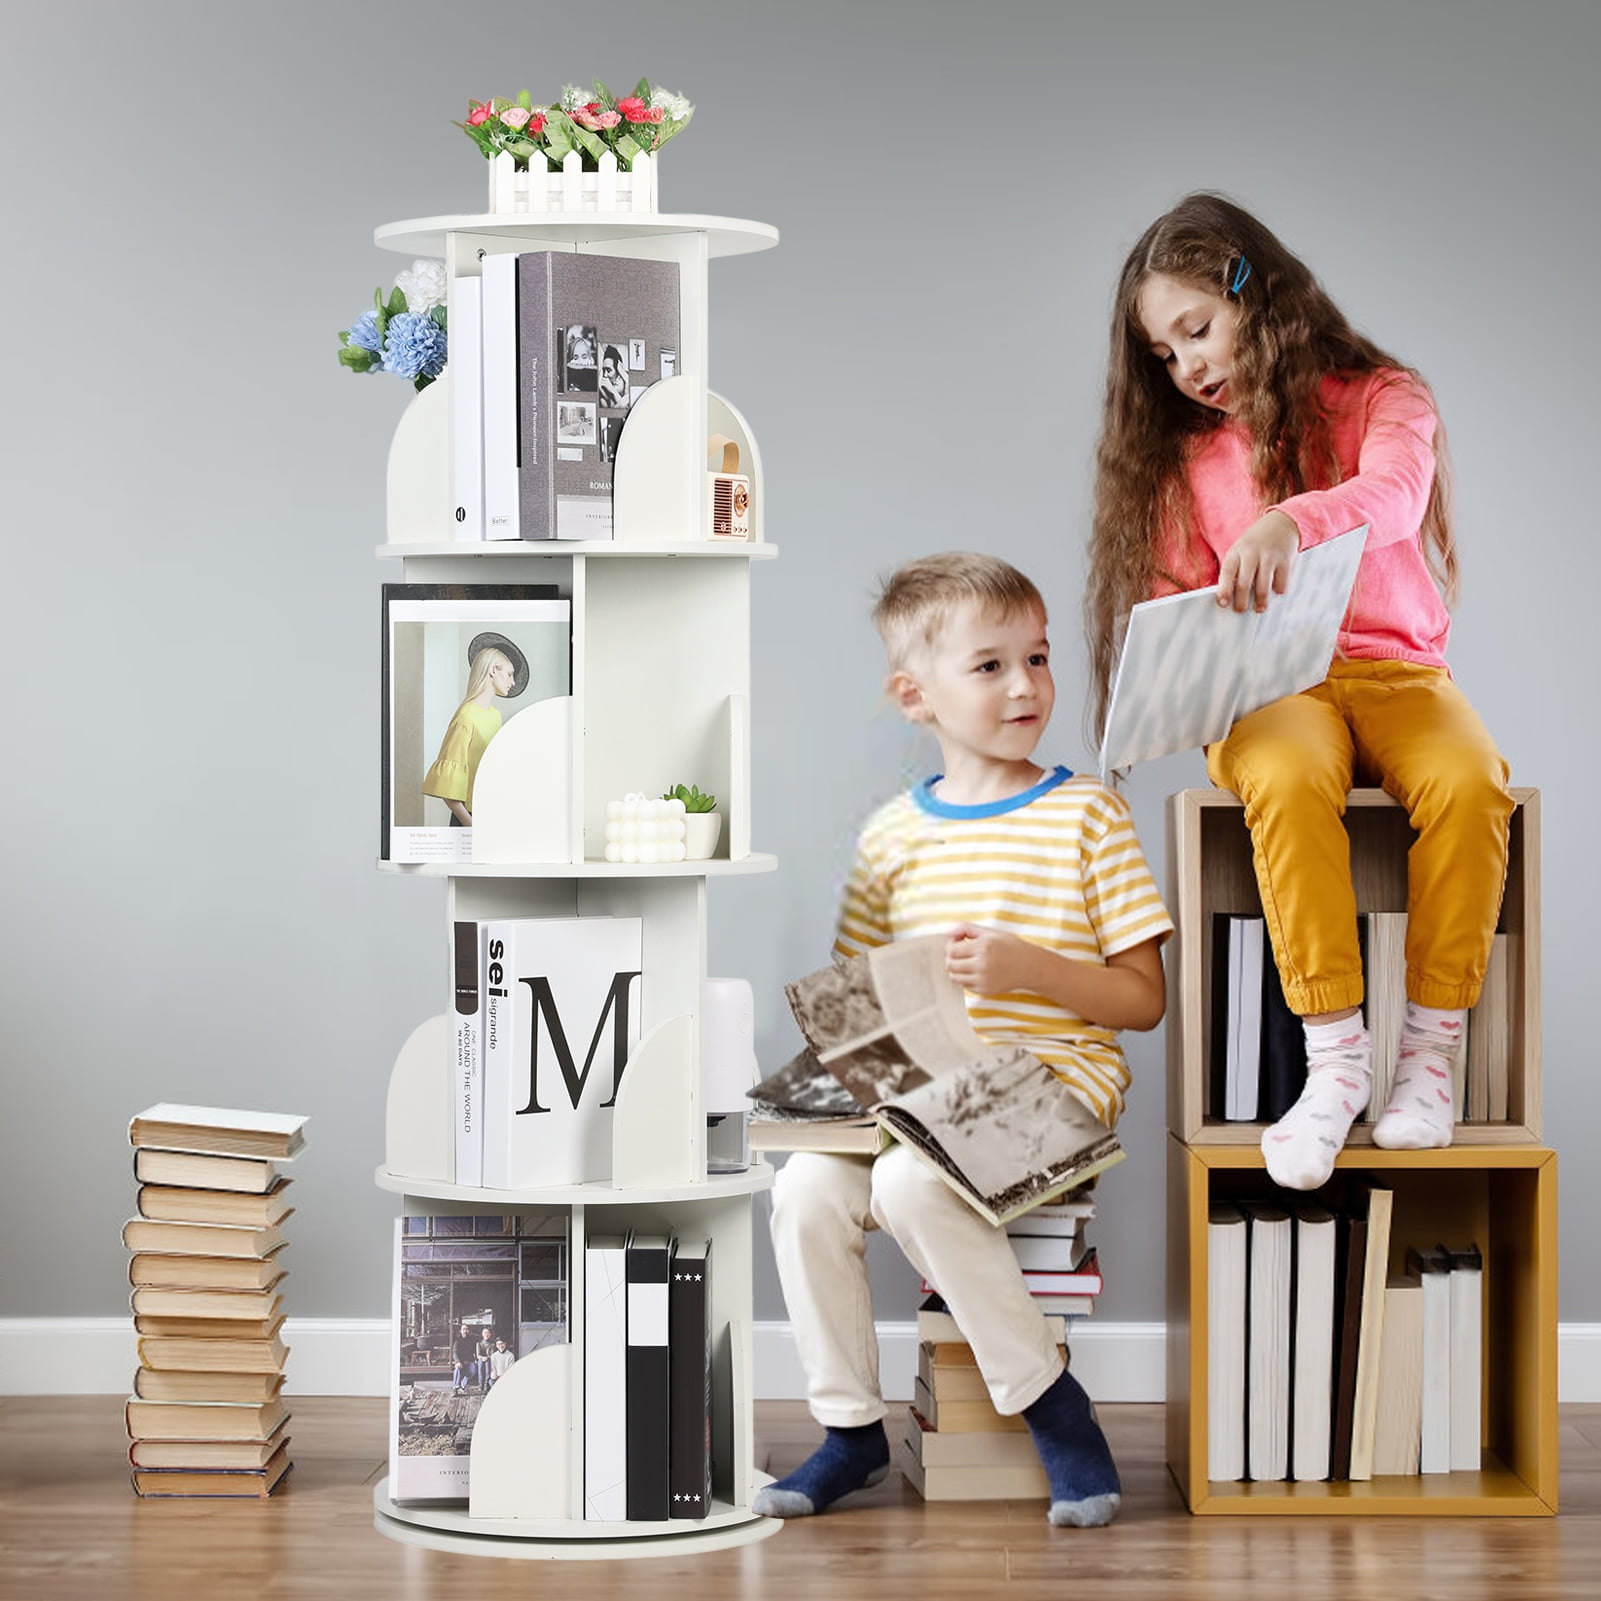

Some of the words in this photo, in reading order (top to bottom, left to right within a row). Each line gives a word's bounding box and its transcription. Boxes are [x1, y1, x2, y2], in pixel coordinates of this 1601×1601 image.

[488, 938, 508, 998] sei
[463, 1022, 471, 1068] AROUND
[488, 998, 498, 1050] sigrande
[515, 971, 642, 1115] M
